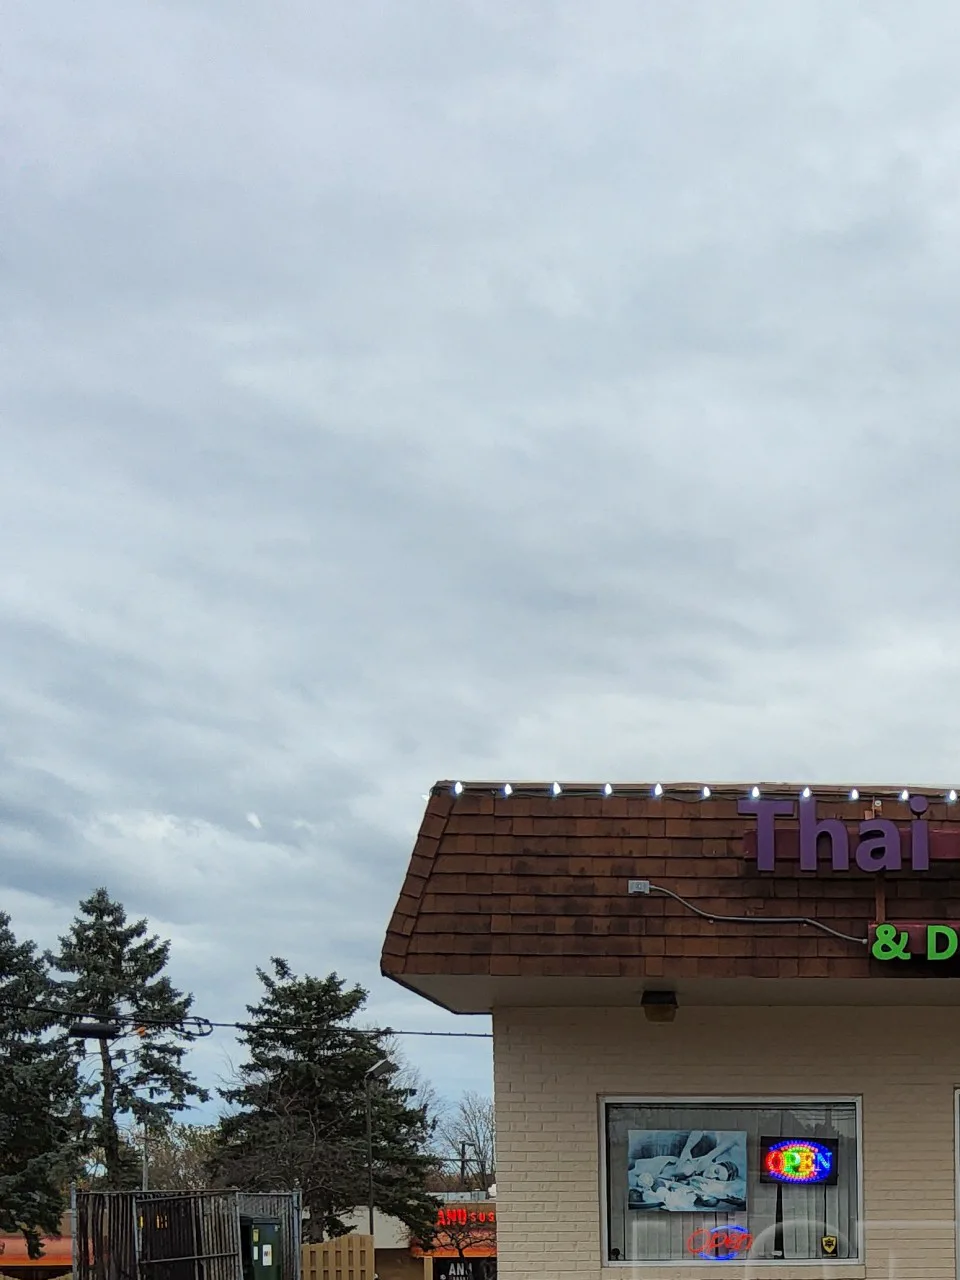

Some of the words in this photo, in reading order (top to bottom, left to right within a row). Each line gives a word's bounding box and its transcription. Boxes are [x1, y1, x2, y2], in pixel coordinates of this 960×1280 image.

[738, 798, 931, 871] Thai
[871, 924, 910, 961] &
[766, 1151, 833, 1172] OPEN
[687, 1228, 754, 1256] Open
